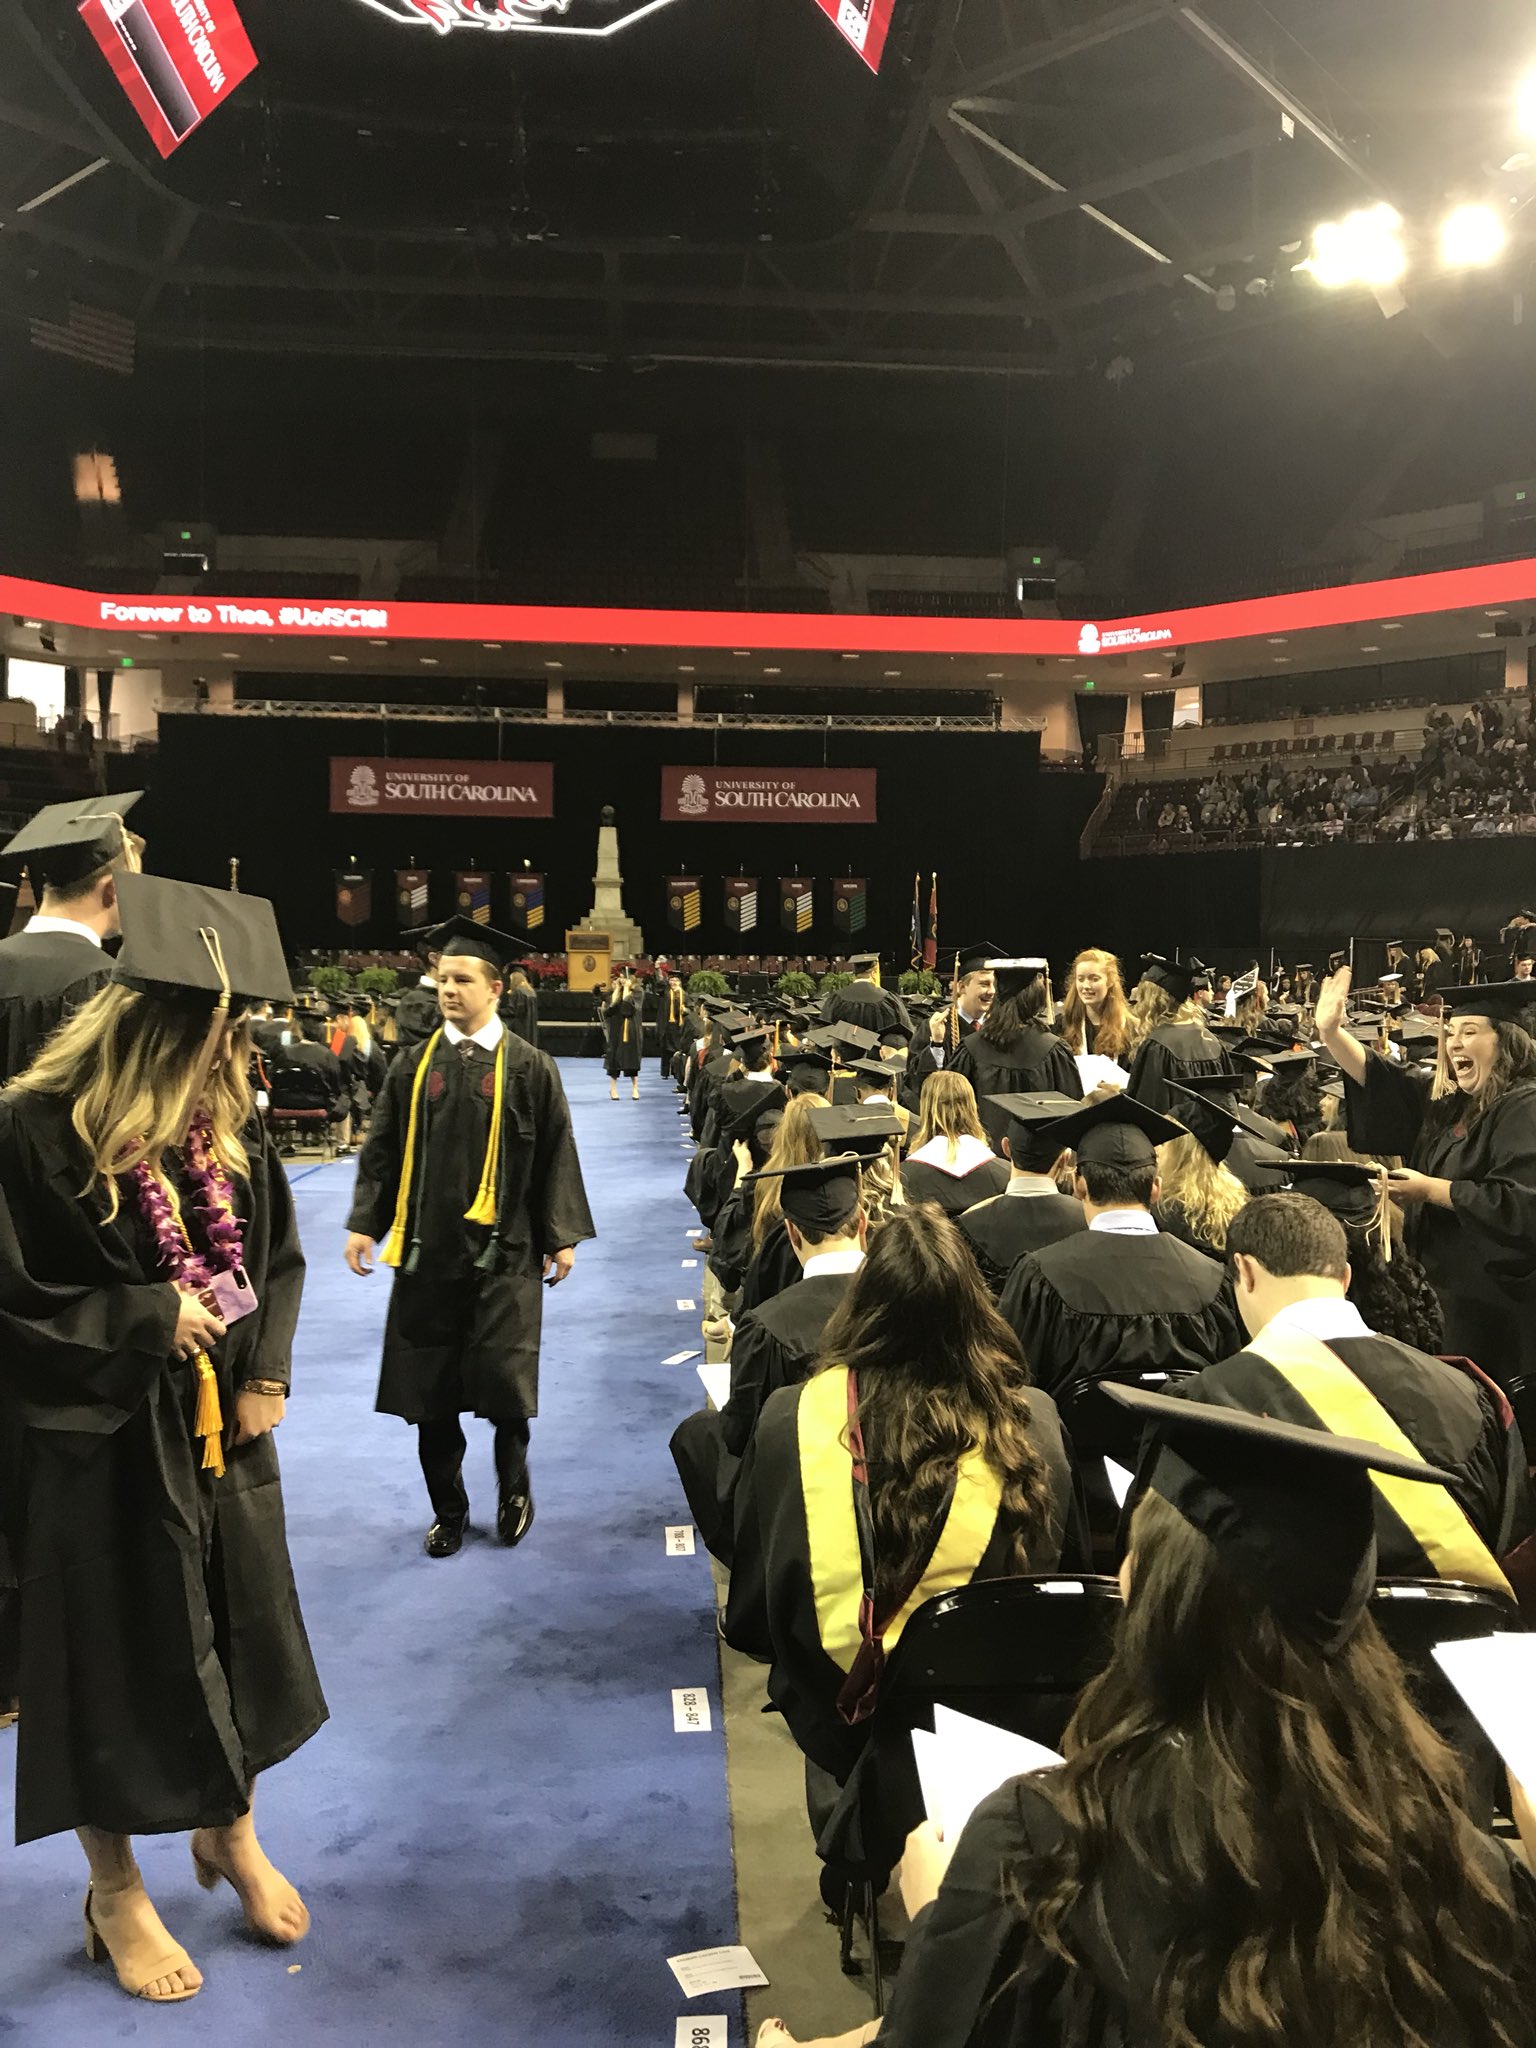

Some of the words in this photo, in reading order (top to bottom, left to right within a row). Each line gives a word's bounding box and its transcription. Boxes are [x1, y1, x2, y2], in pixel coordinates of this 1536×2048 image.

[100, 602, 183, 622] Forever
[187, 605, 212, 623] to
[385, 772, 451, 782] UNIVERSITY
[454, 774, 470, 782] OF
[715, 780, 780, 789] UNIVERSITY
[782, 781, 797, 789] OF
[384, 782, 446, 800] SOUTH
[447, 784, 538, 802] CAROLINA
[714, 791, 775, 807] SOUTH
[774, 791, 861, 808] CAROLINA
[682, 1693, 697, 1706] 828
[685, 1712, 700, 1725] 847
[691, 2027, 710, 2048] 86
